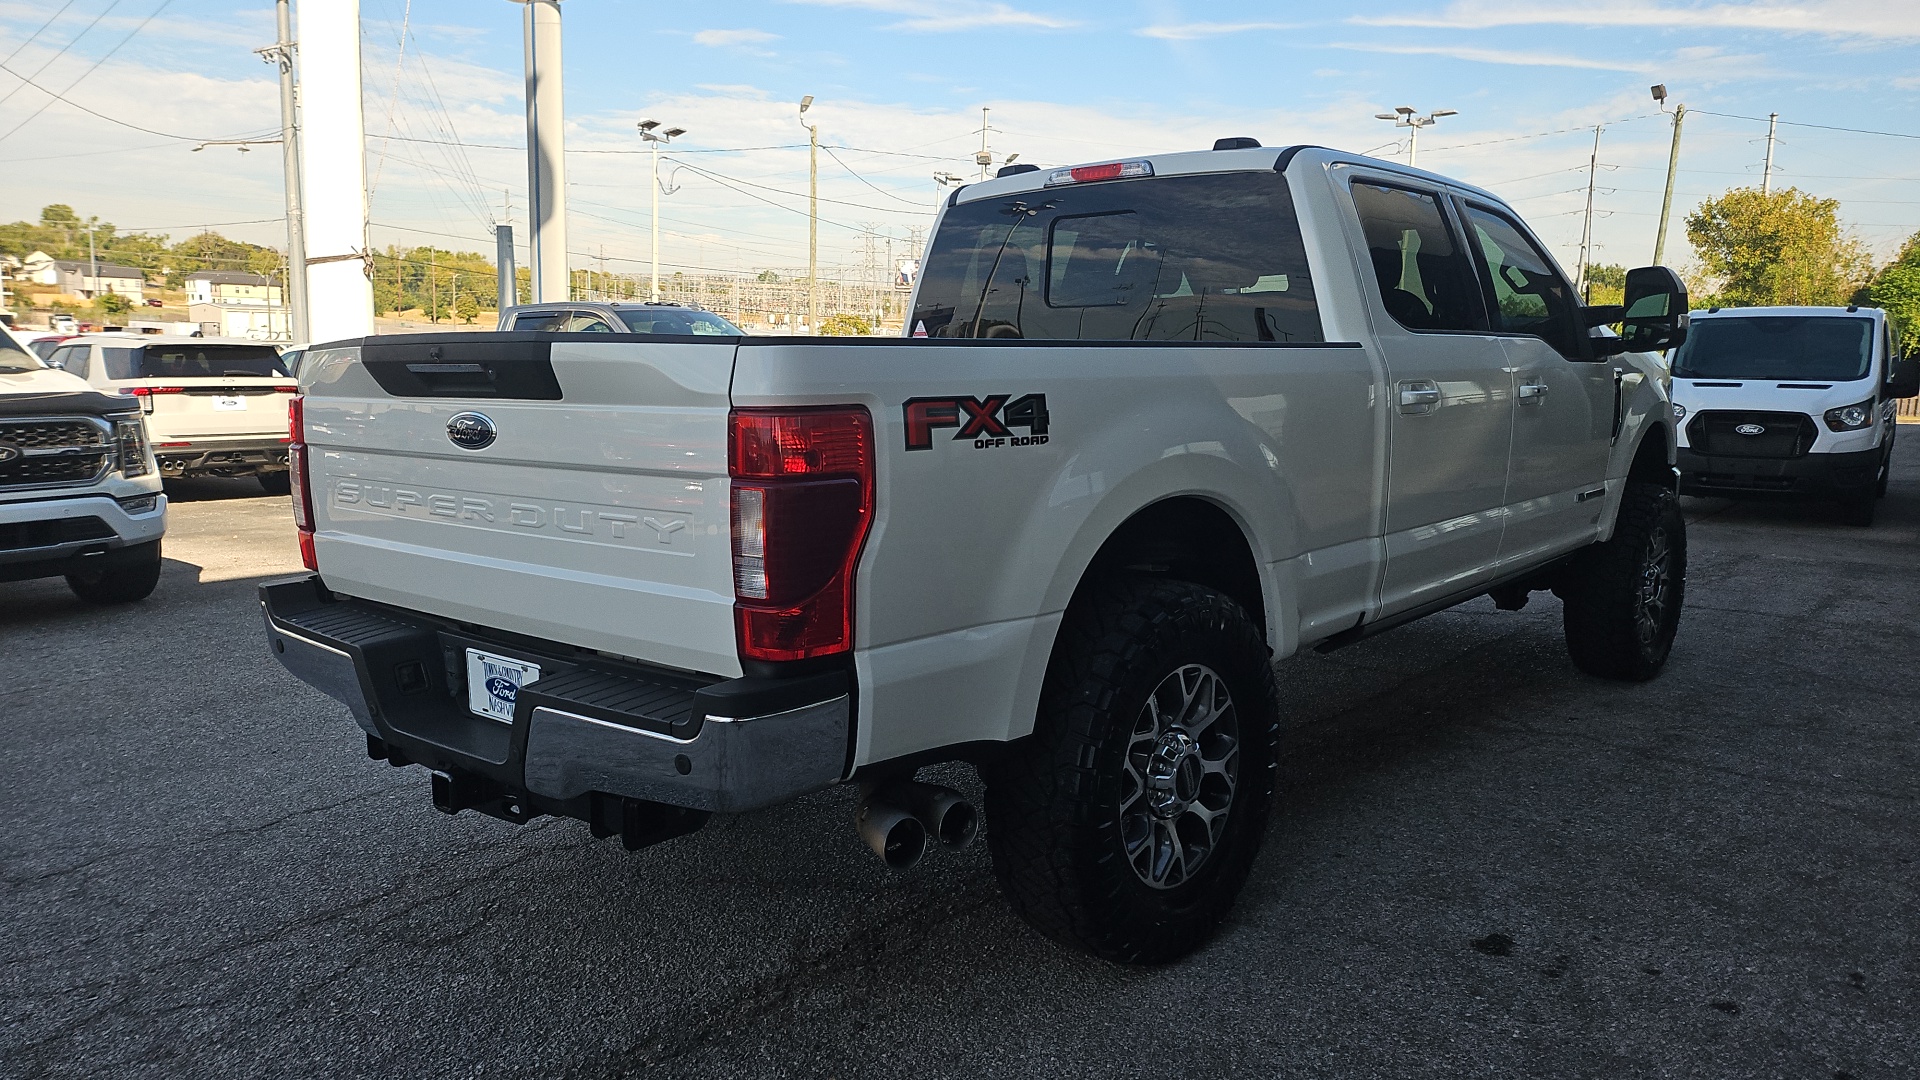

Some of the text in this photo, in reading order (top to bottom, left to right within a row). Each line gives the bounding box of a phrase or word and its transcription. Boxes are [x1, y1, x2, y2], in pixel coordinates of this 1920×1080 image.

[455, 419, 482, 440] Ford
[902, 393, 1050, 451] FX4
[974, 435, 1049, 449] OFF ROAD
[337, 482, 686, 544] SUPER DUTY
[492, 679, 516, 700] Ford
[489, 694, 514, 717] NASHVI
